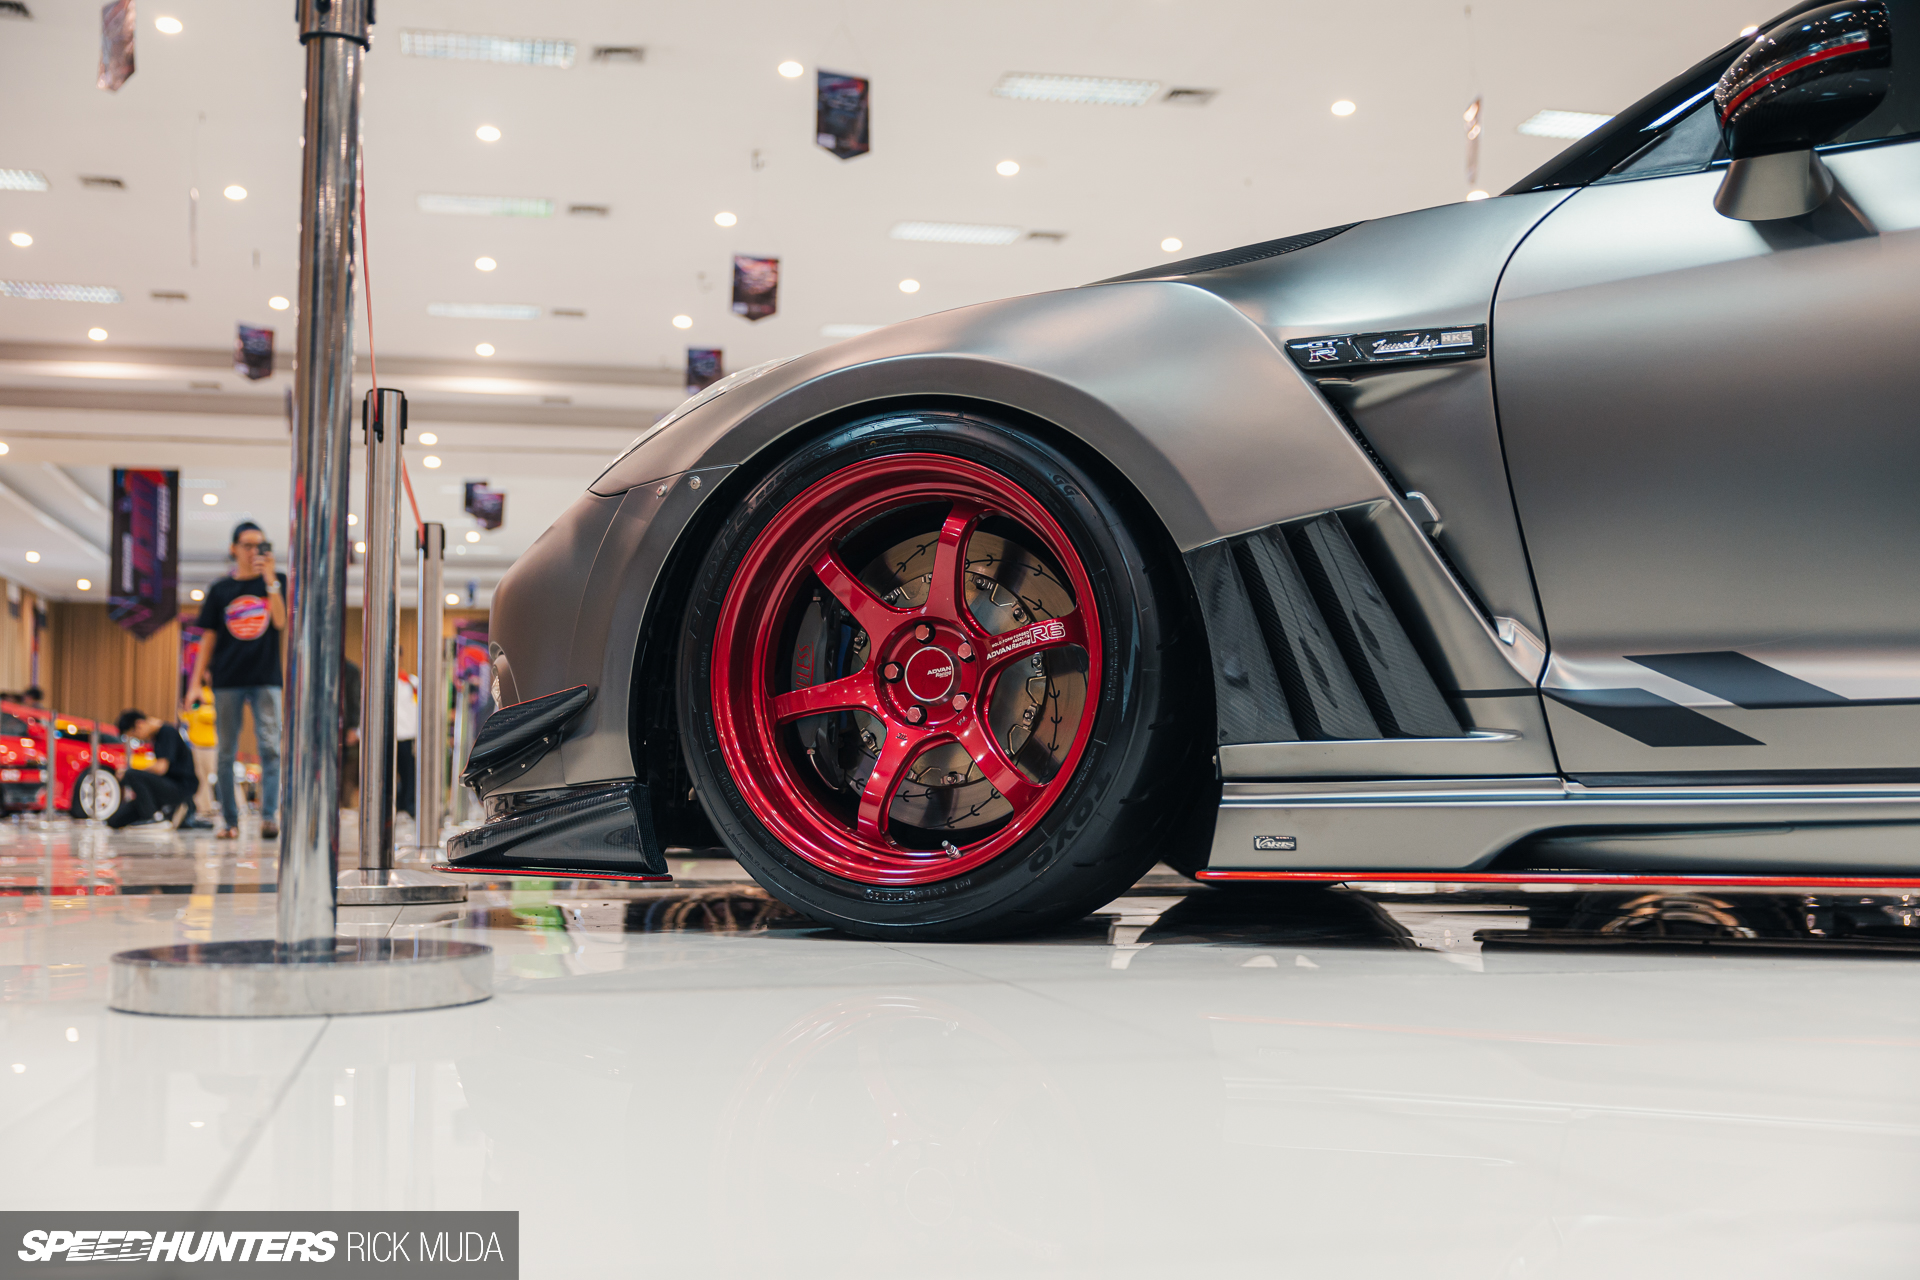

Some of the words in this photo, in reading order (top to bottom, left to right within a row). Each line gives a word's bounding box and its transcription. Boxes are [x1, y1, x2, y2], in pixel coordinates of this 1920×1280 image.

[1441, 331, 1473, 345] HKS
[1029, 622, 1066, 643] R6
[987, 644, 1012, 660] ADVAN
[1011, 638, 1031, 650] Racing
[795, 643, 811, 689] DLESS
[927, 666, 952, 676] ADVAN
[935, 670, 952, 678] Racing
[1029, 772, 1112, 872] TOYO
[1255, 838, 1295, 849] VARIS
